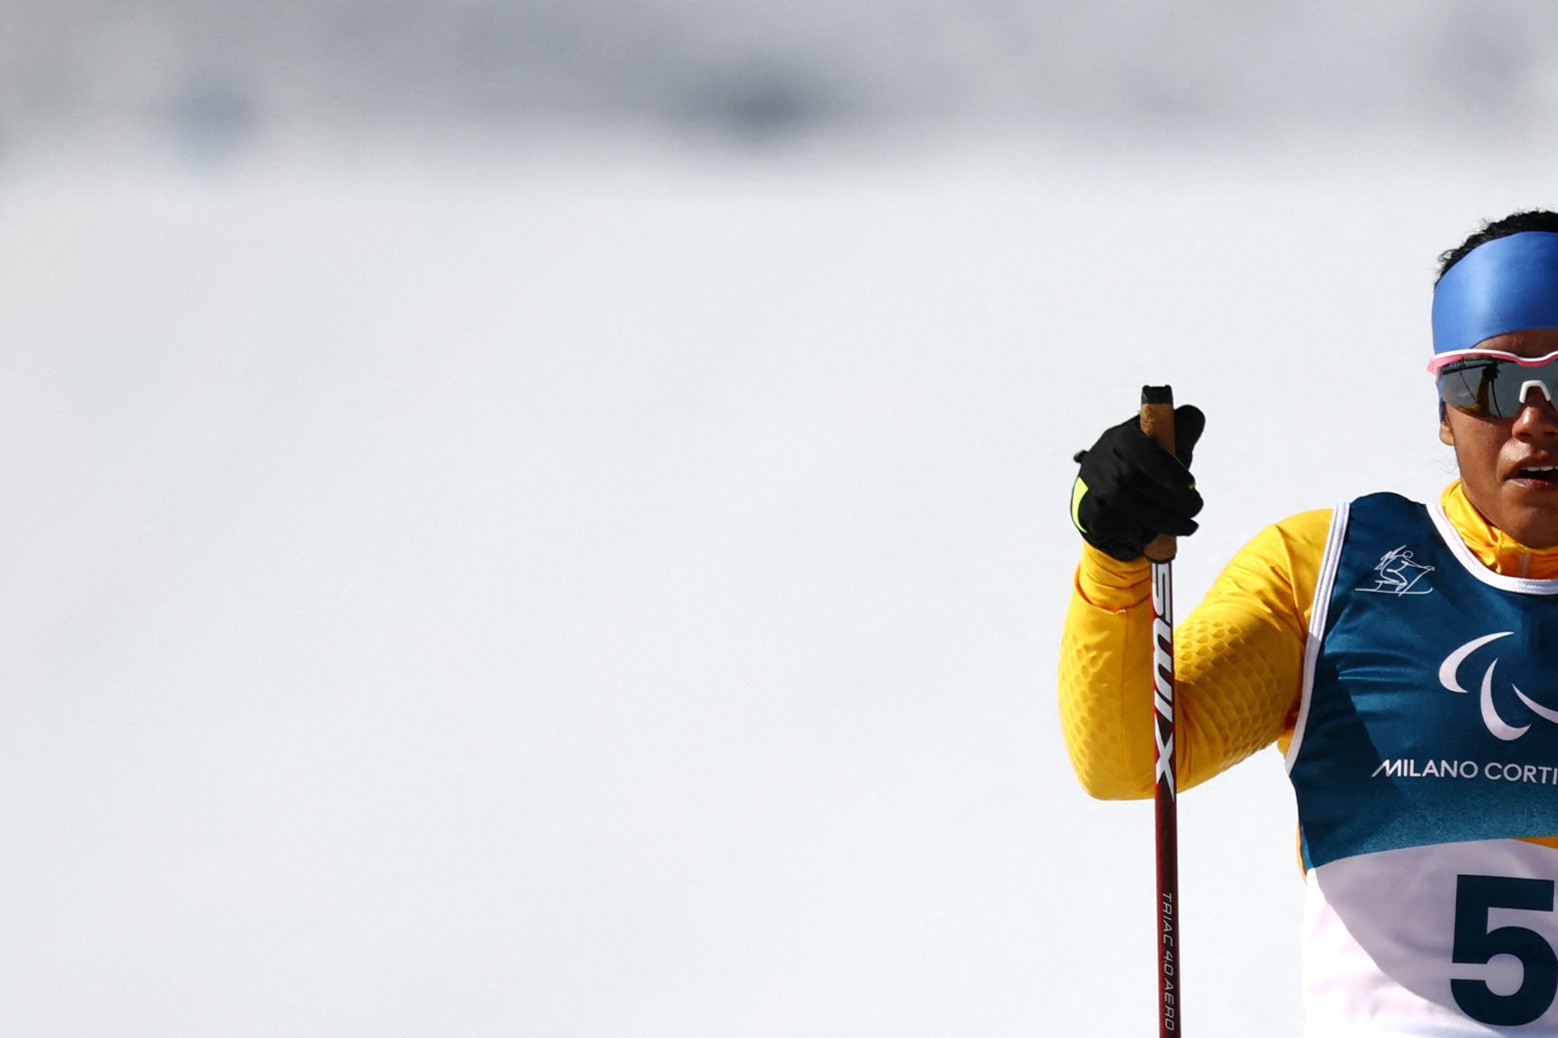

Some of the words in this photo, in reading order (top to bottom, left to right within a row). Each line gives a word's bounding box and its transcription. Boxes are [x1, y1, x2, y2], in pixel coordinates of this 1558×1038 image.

[1371, 758, 1479, 779] MILANO
[1162, 892, 1174, 947] TRIAC
[1164, 977, 1175, 1031] AERO
